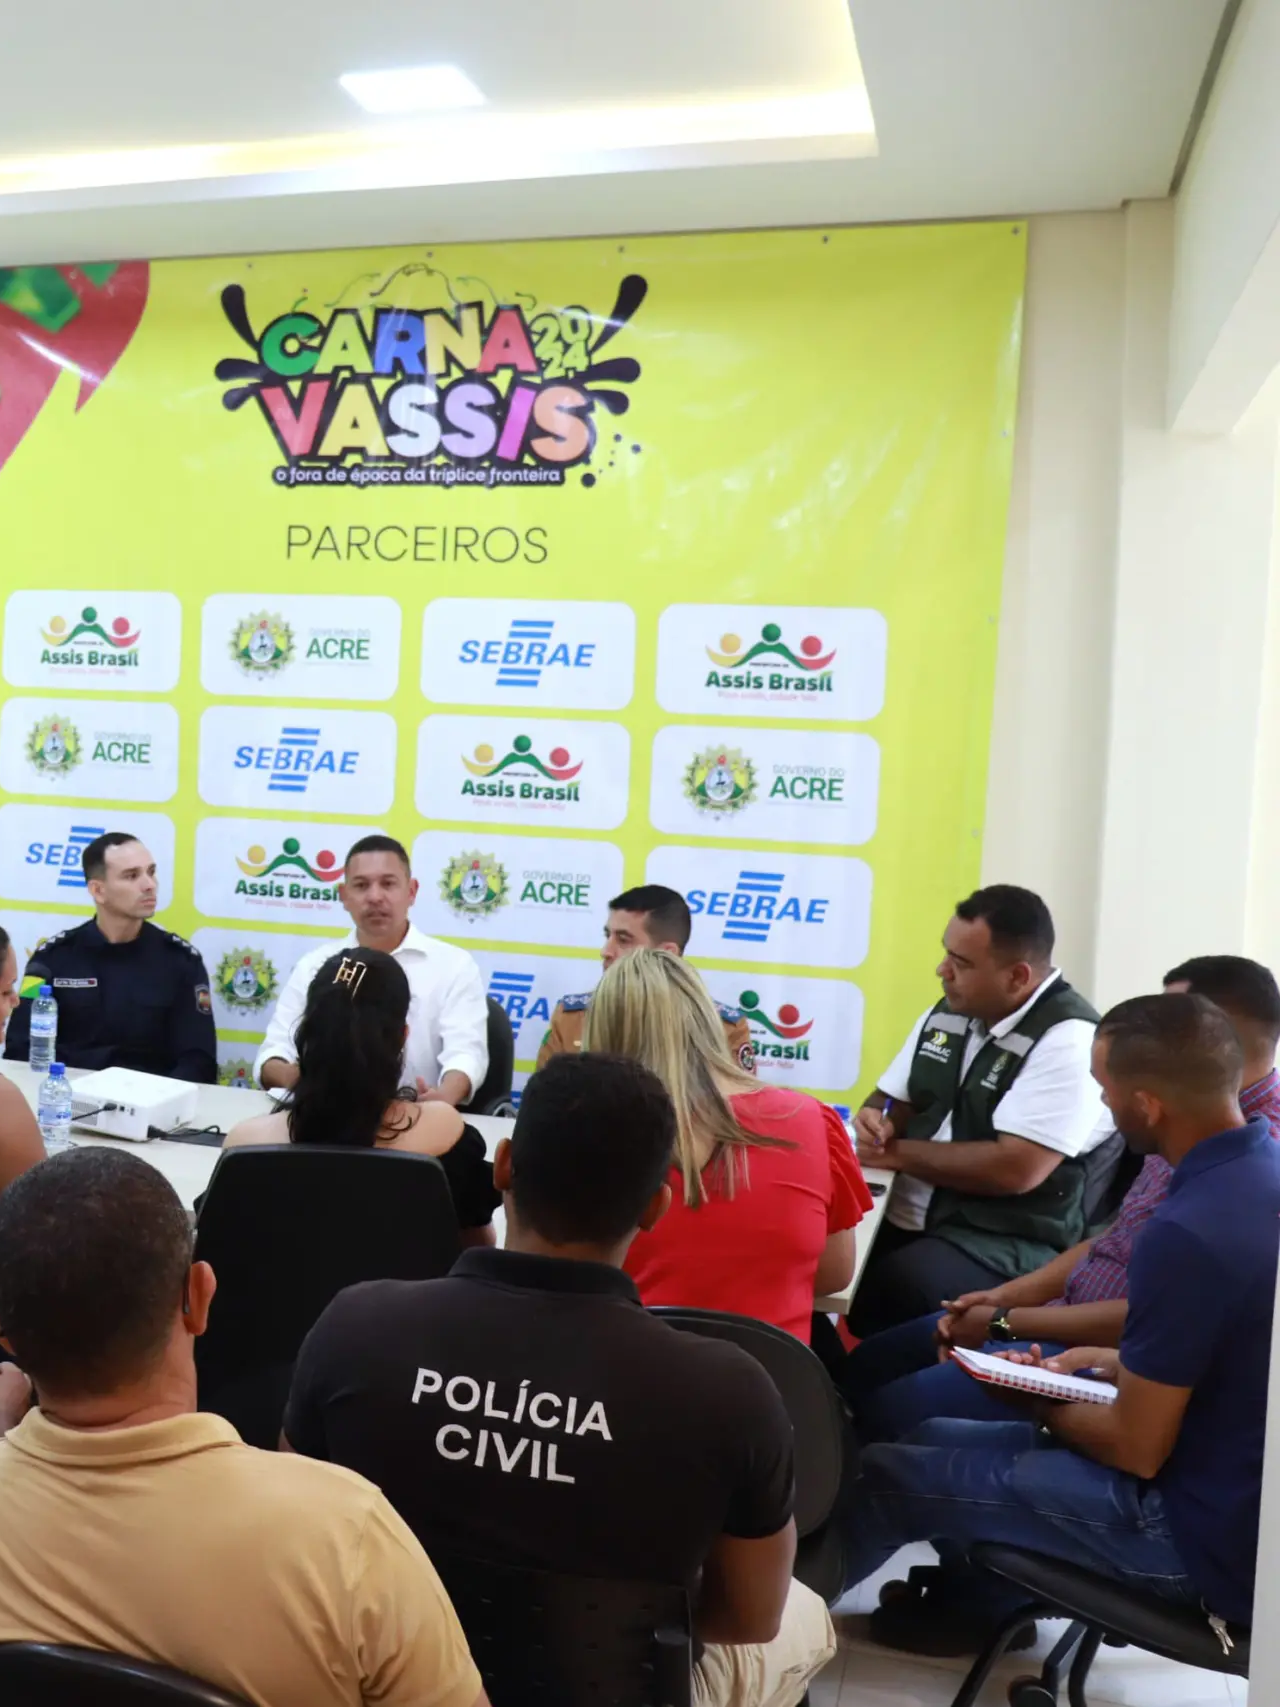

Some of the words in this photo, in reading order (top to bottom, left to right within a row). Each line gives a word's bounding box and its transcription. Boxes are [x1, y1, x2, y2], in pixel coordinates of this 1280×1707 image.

[259, 306, 539, 377] CARNA
[259, 383, 589, 461] VASSIS
[275, 471, 287, 481] o
[289, 467, 322, 484] fora
[325, 467, 347, 481] de
[350, 467, 401, 484] época
[403, 467, 426, 481] da
[488, 467, 561, 484] fronteira
[286, 525, 549, 564] PARCEIROS
[40, 649, 83, 665] Assis
[87, 648, 139, 667] Brasil
[306, 638, 370, 660] ACRE
[459, 640, 596, 667] SEBRAE
[705, 670, 763, 689] Assis
[768, 670, 833, 692] Brasil
[92, 741, 151, 764] ACRE
[234, 746, 360, 774] SEBRAE
[461, 779, 514, 797] Assis
[520, 780, 580, 802] Brasil
[768, 776, 844, 801] ACRE
[25, 842, 82, 866] SEB
[234, 879, 284, 898] Assis
[288, 883, 339, 901] Brasi
[520, 880, 590, 906] ACRE
[686, 890, 829, 923] SEBRAE
[411, 1367, 613, 1441] POLÍCIA
[435, 1424, 575, 1484] CIVIL
